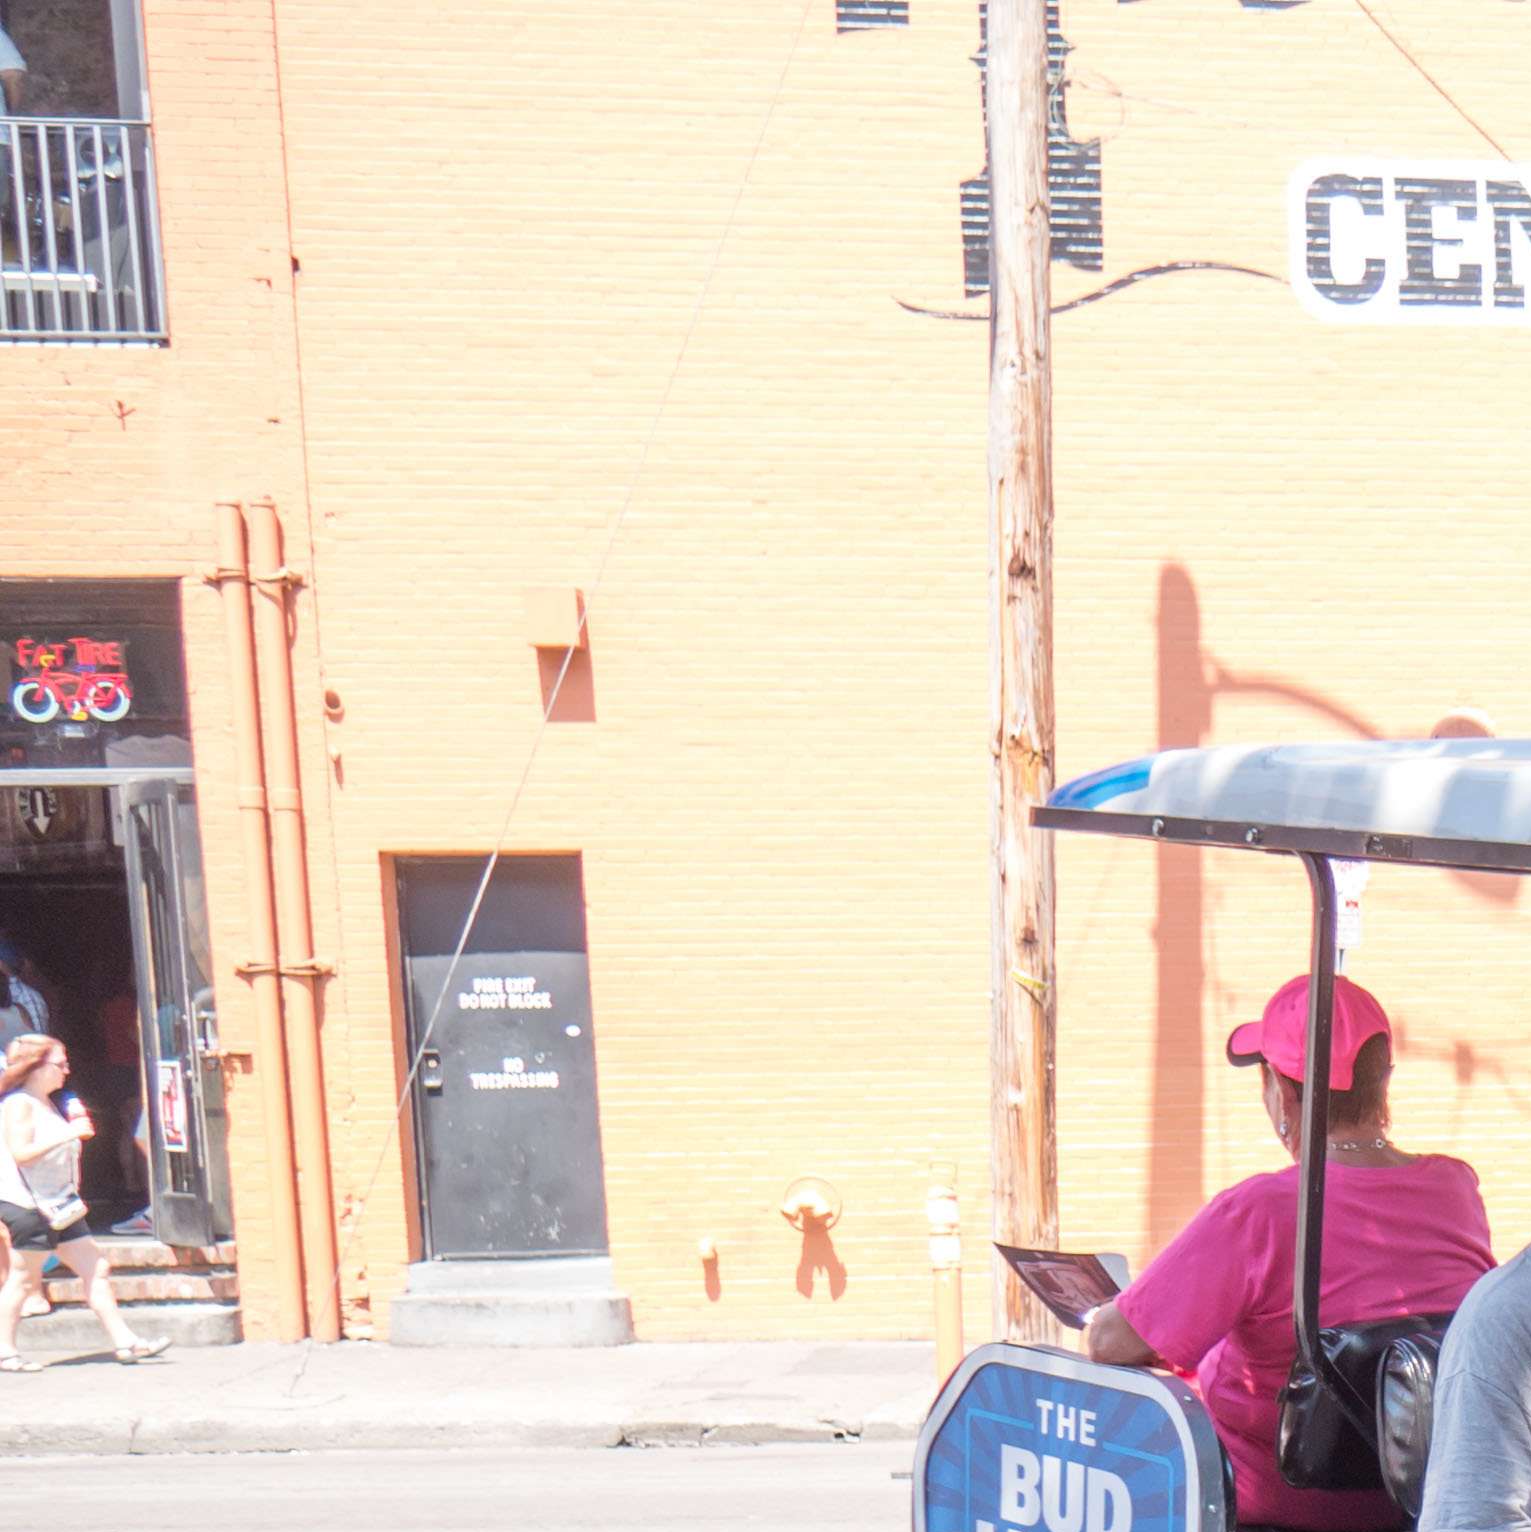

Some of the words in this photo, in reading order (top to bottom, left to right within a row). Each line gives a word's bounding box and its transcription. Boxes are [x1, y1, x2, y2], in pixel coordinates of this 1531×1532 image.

[16, 637, 68, 668] FAT
[67, 636, 123, 667] TIRE
[1036, 1398, 1097, 1447] THE
